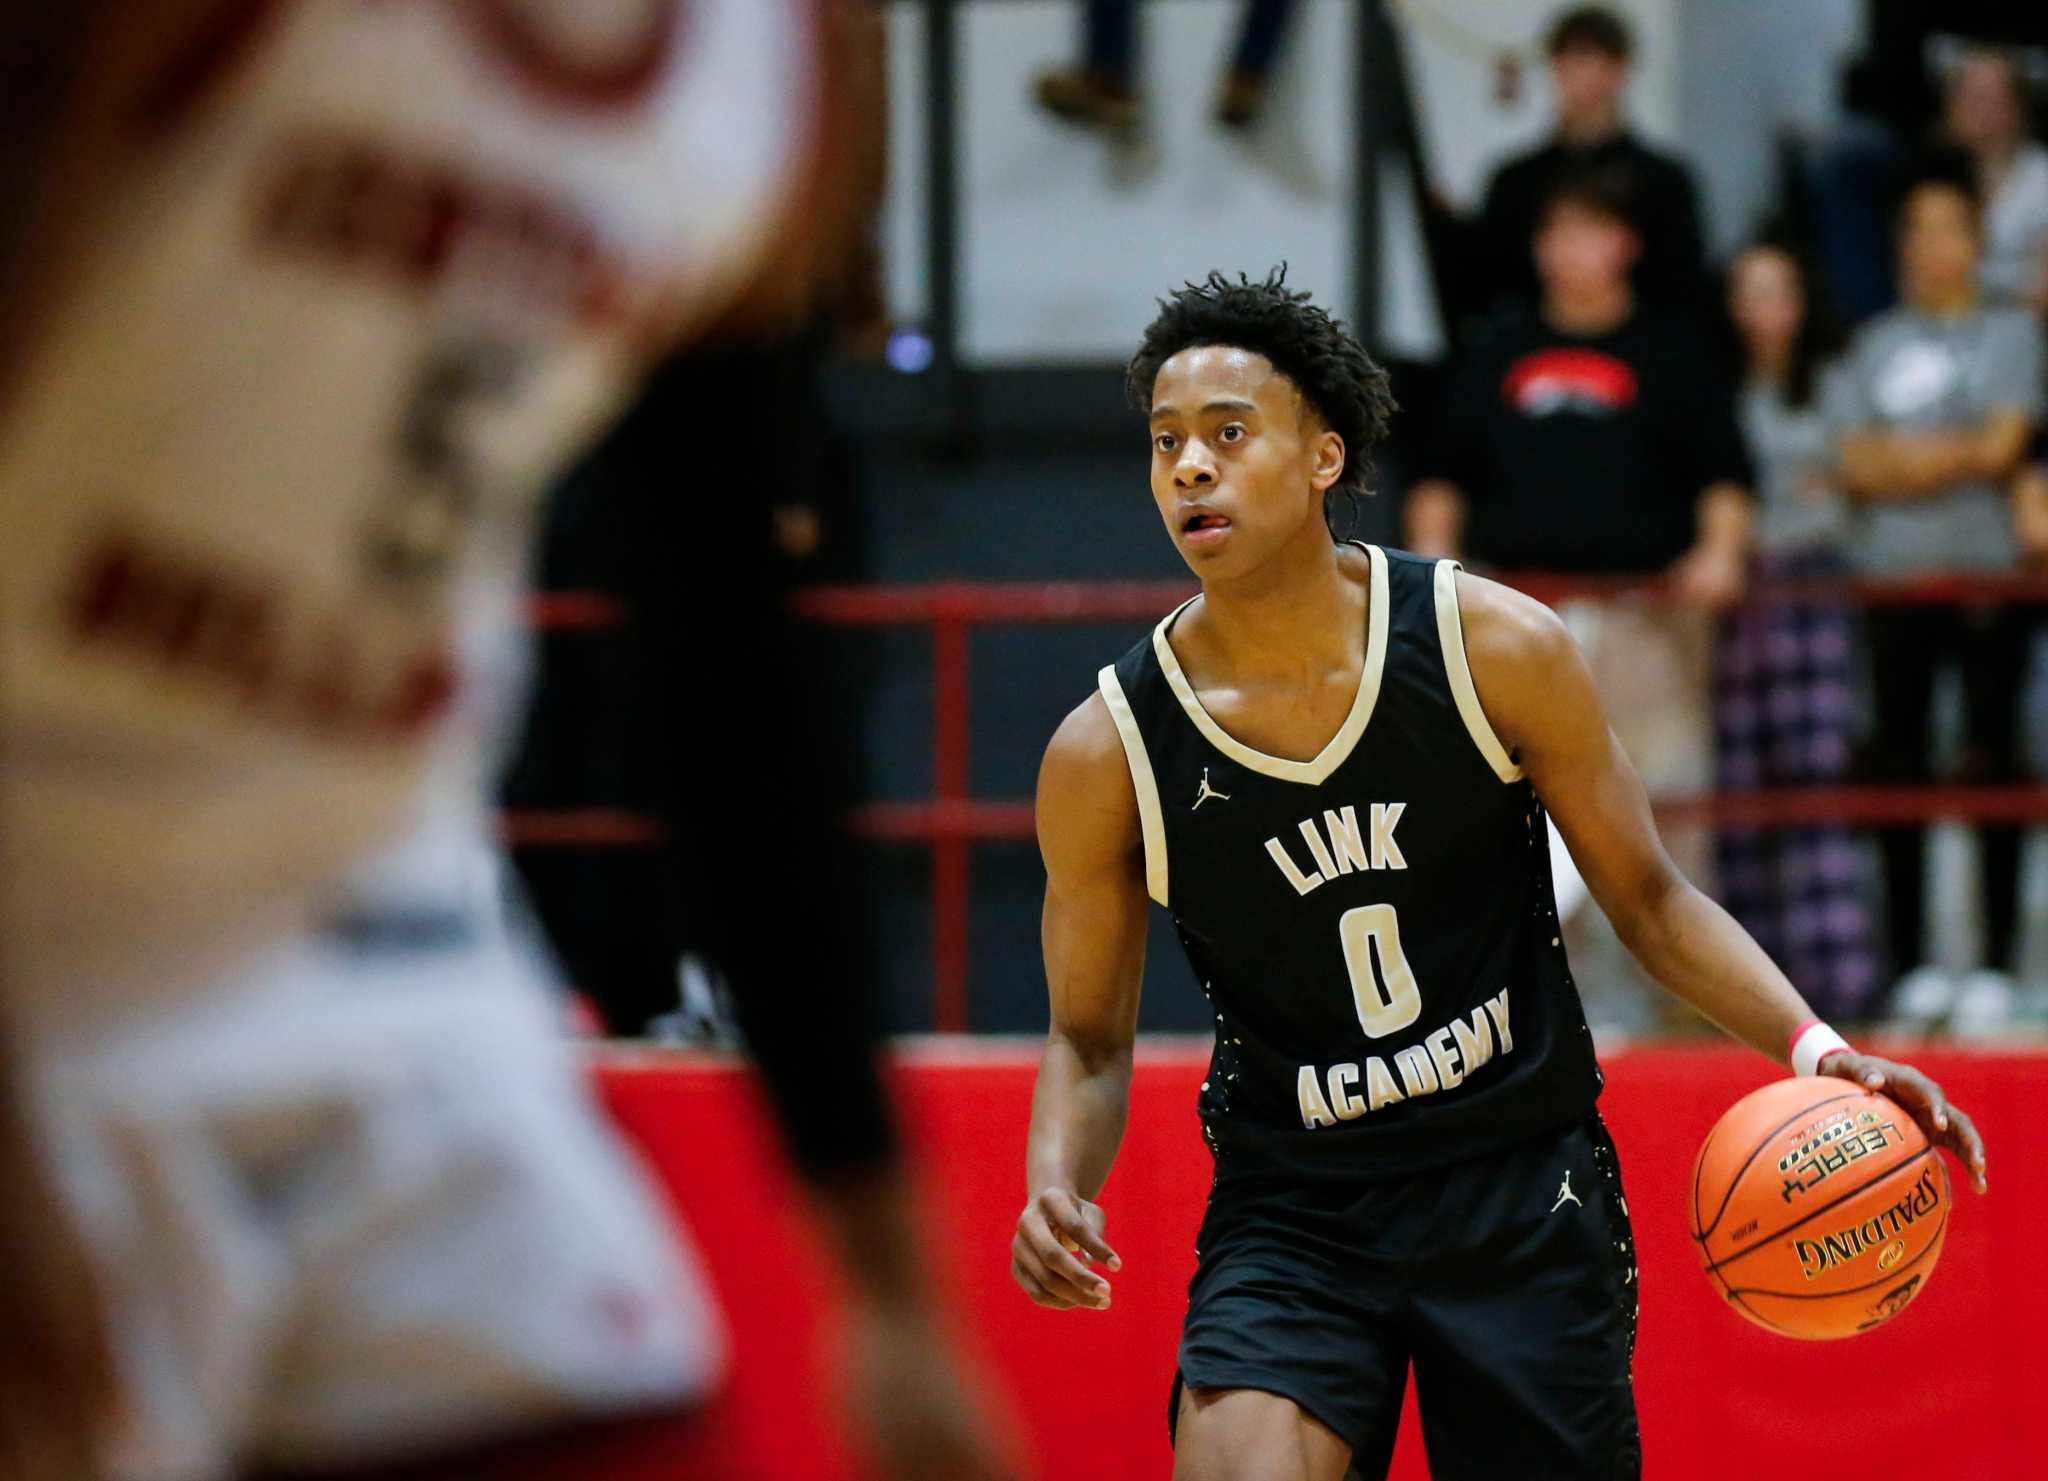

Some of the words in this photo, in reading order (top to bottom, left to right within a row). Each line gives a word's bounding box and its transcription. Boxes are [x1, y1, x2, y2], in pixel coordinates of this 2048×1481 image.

[1264, 802, 1408, 896] LINK
[1339, 903, 1422, 1040] 0
[1297, 987, 1513, 1130] ACADEMY
[1781, 1122, 1905, 1203] LEGACY
[1793, 1168, 1939, 1280] SPALDING
